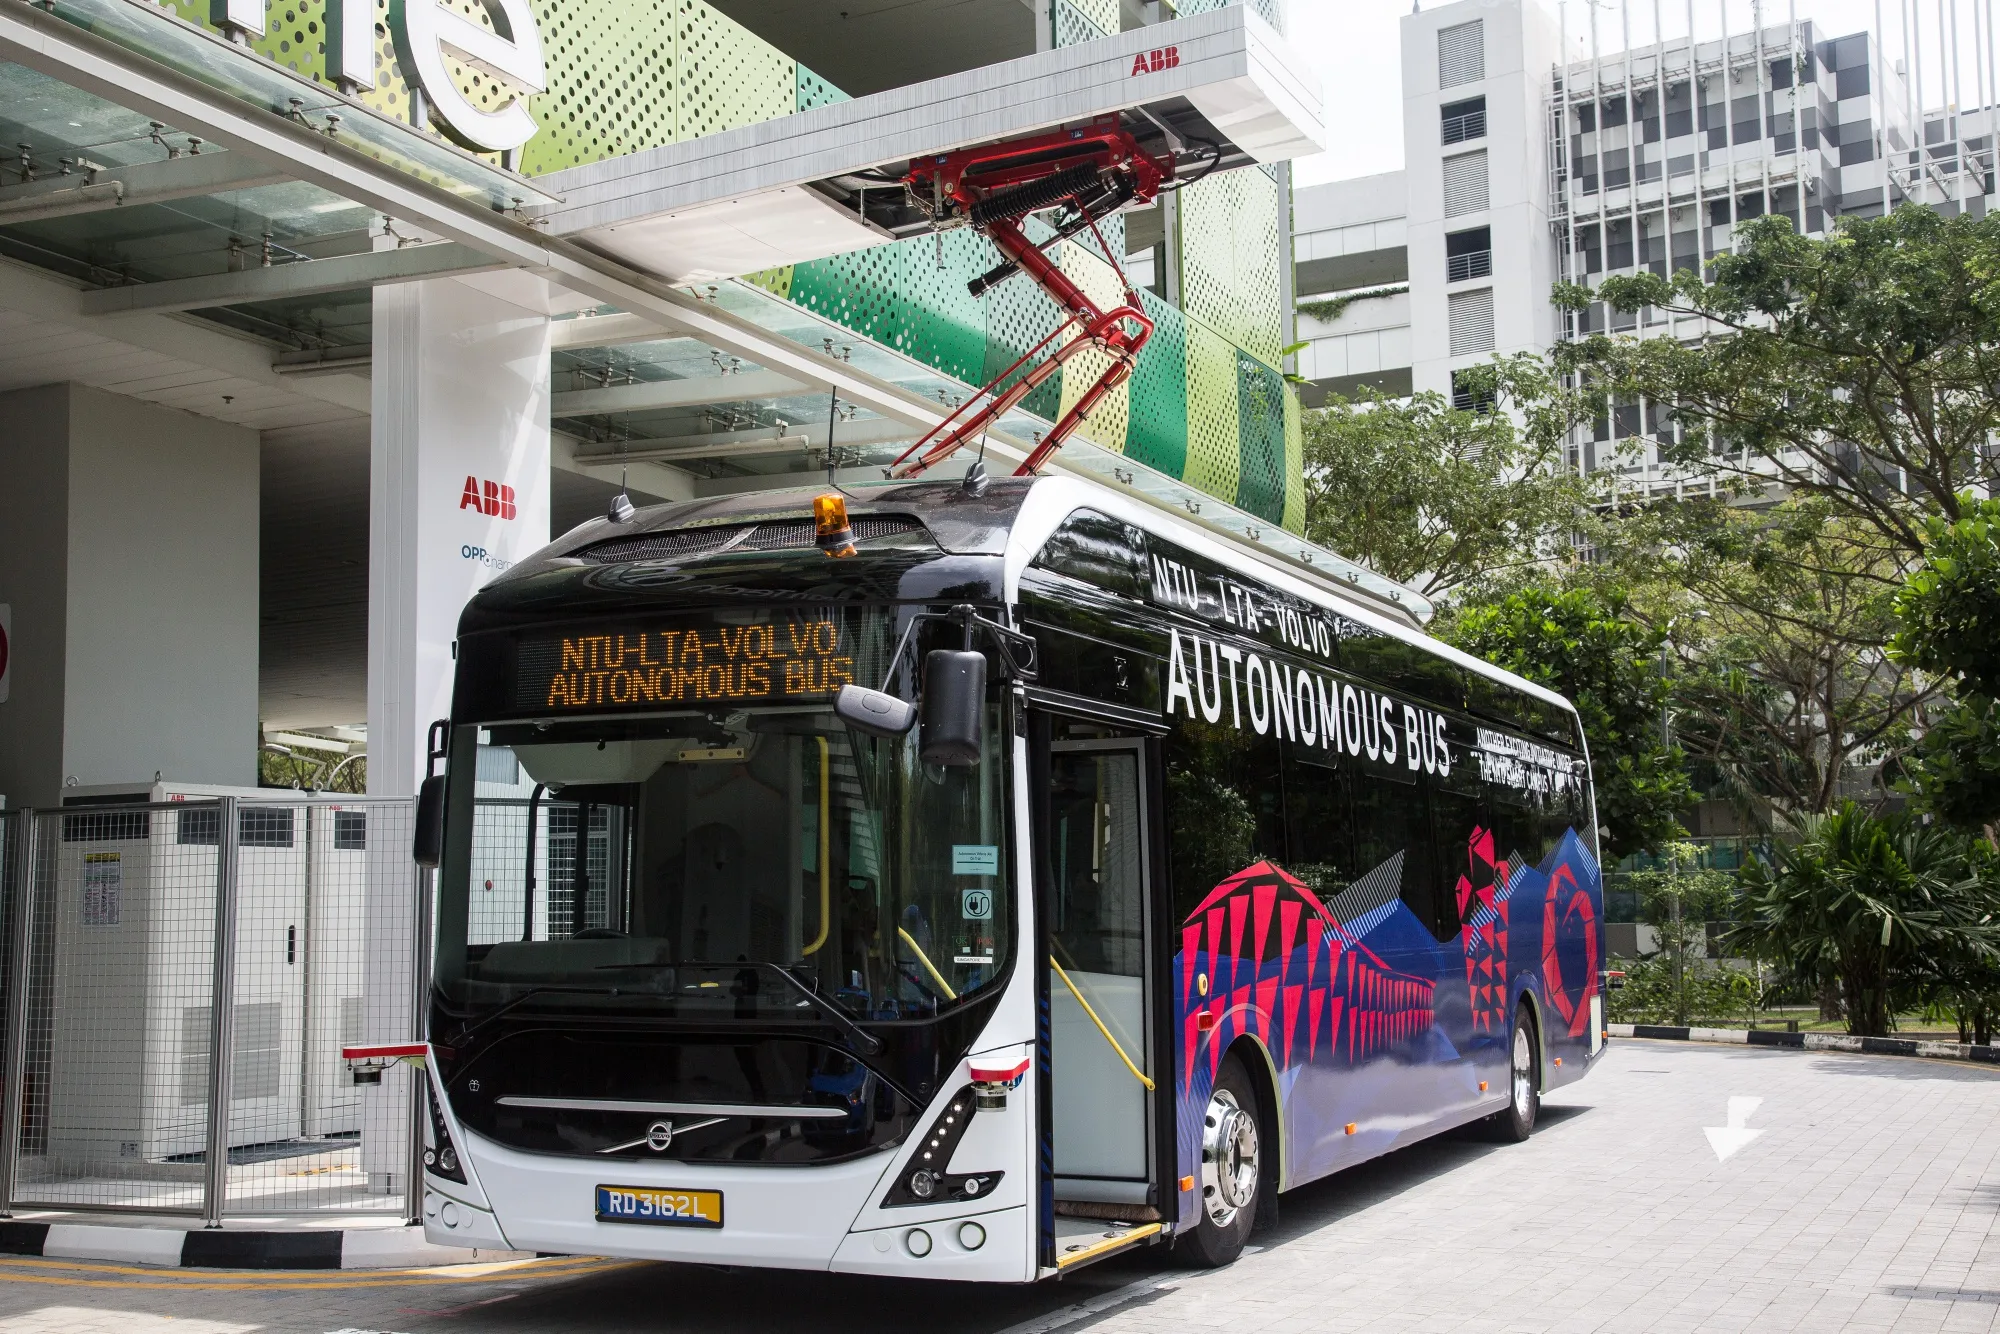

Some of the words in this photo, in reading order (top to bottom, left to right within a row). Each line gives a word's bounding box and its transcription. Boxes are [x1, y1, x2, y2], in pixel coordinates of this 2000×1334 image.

[1131, 46, 1180, 77] ABB
[459, 475, 517, 521] ABB
[1152, 553, 1199, 611] NTU
[1219, 581, 1261, 633] LTA
[1274, 602, 1330, 657] VOLVO
[548, 661, 770, 706] AUTONOMOUS
[785, 657, 853, 694] BUS
[1166, 628, 1397, 765] AUTONOMOUS
[1403, 704, 1450, 777] BUS
[1480, 758, 1493, 782] THE
